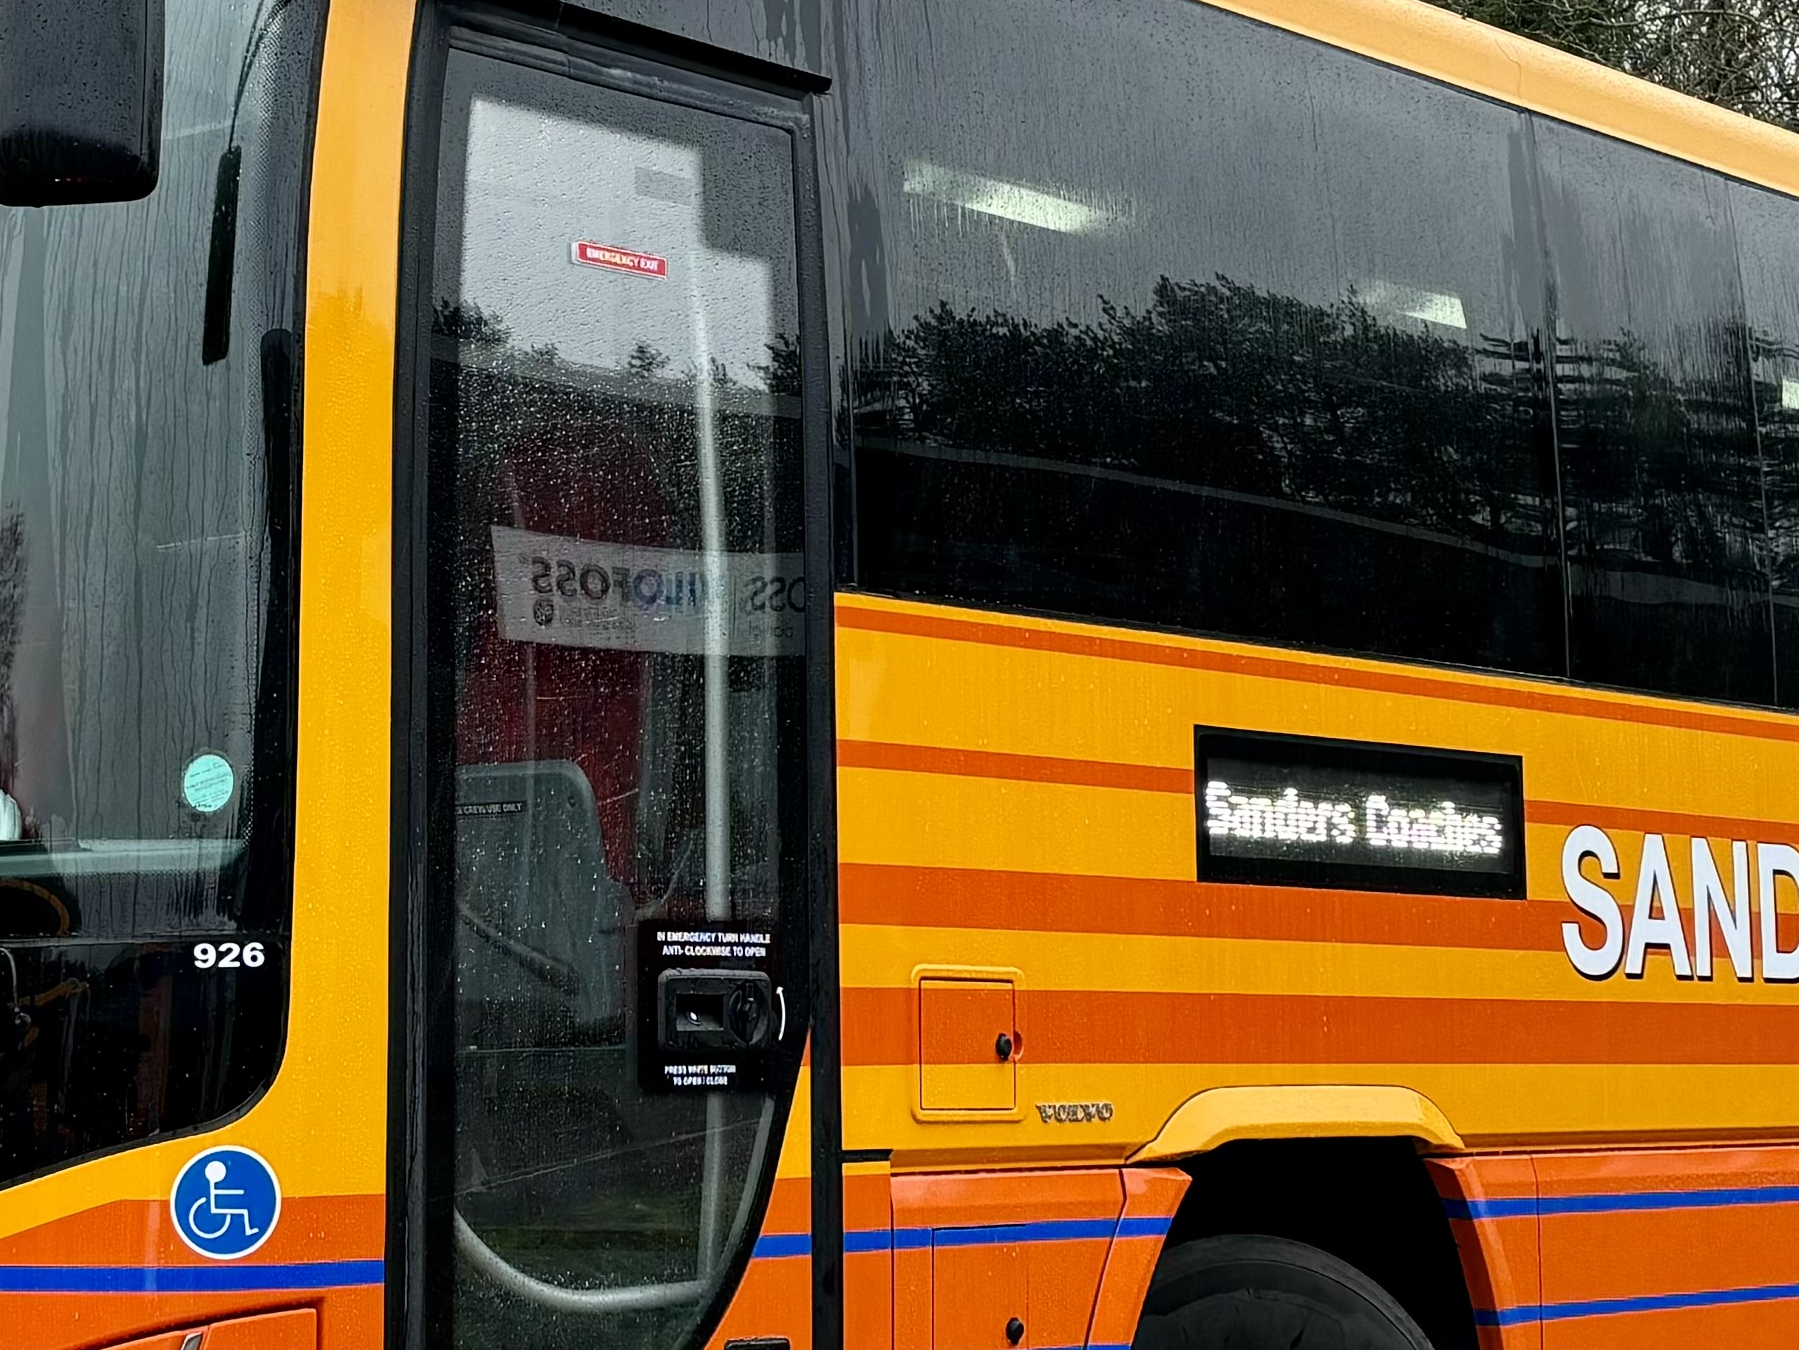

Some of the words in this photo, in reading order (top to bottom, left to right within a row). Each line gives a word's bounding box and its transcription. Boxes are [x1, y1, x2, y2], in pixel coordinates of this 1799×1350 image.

[1205, 780, 1356, 845] Sanders
[1365, 794, 1502, 854] Coaches
[667, 932, 716, 943] EMERGENCY
[717, 932, 739, 943] TURN
[739, 933, 771, 944] HANDLE
[193, 941, 266, 969] 926
[733, 946, 743, 957] TO
[744, 946, 766, 957] OPEN
[1035, 1103, 1114, 1123] VOLVO
